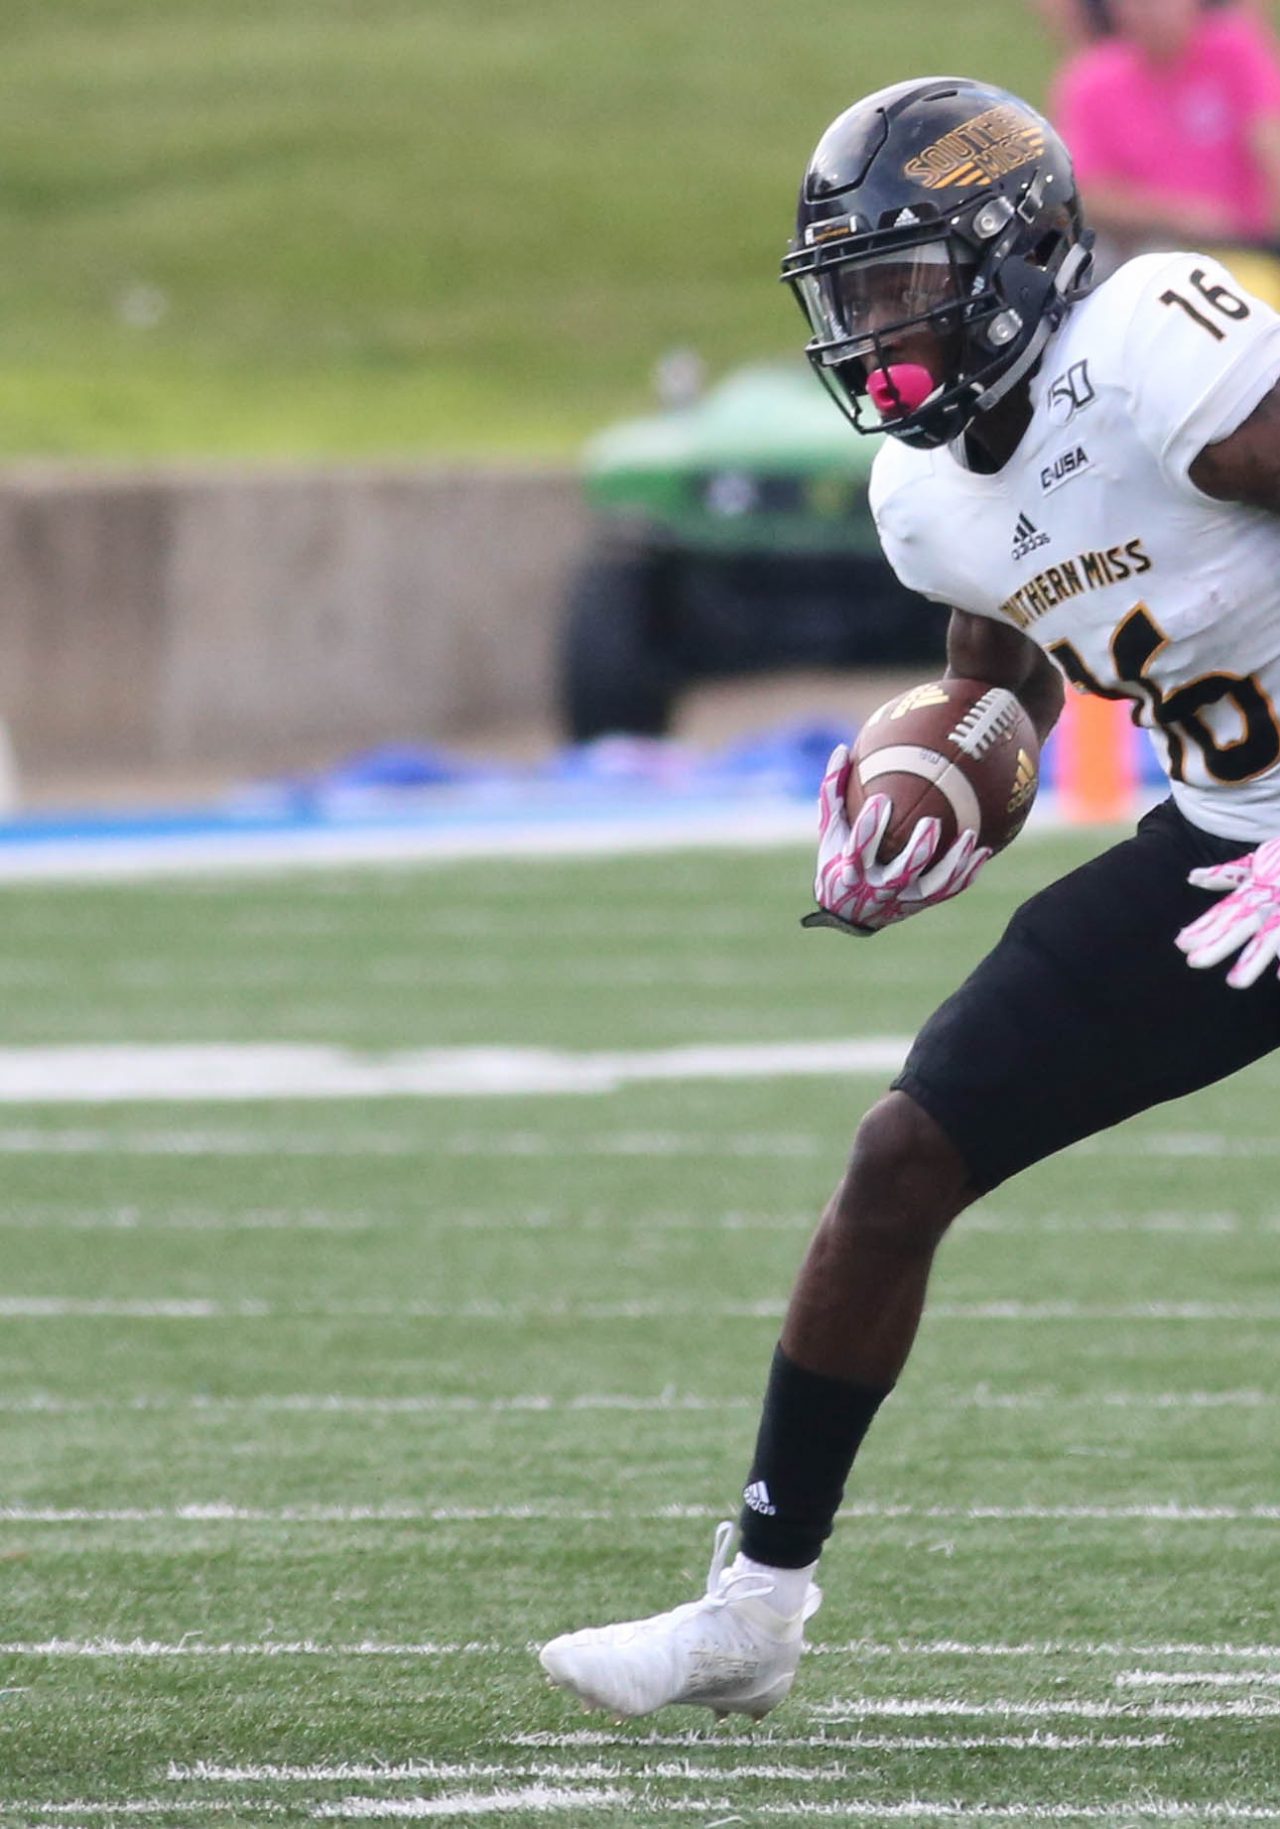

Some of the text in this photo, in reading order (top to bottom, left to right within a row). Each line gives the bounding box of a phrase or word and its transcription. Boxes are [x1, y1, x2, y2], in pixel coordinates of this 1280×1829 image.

[1158, 267, 1251, 343] 16
[998, 536, 1152, 631] UTHERN MISS
[1011, 531, 1051, 561] adidas
